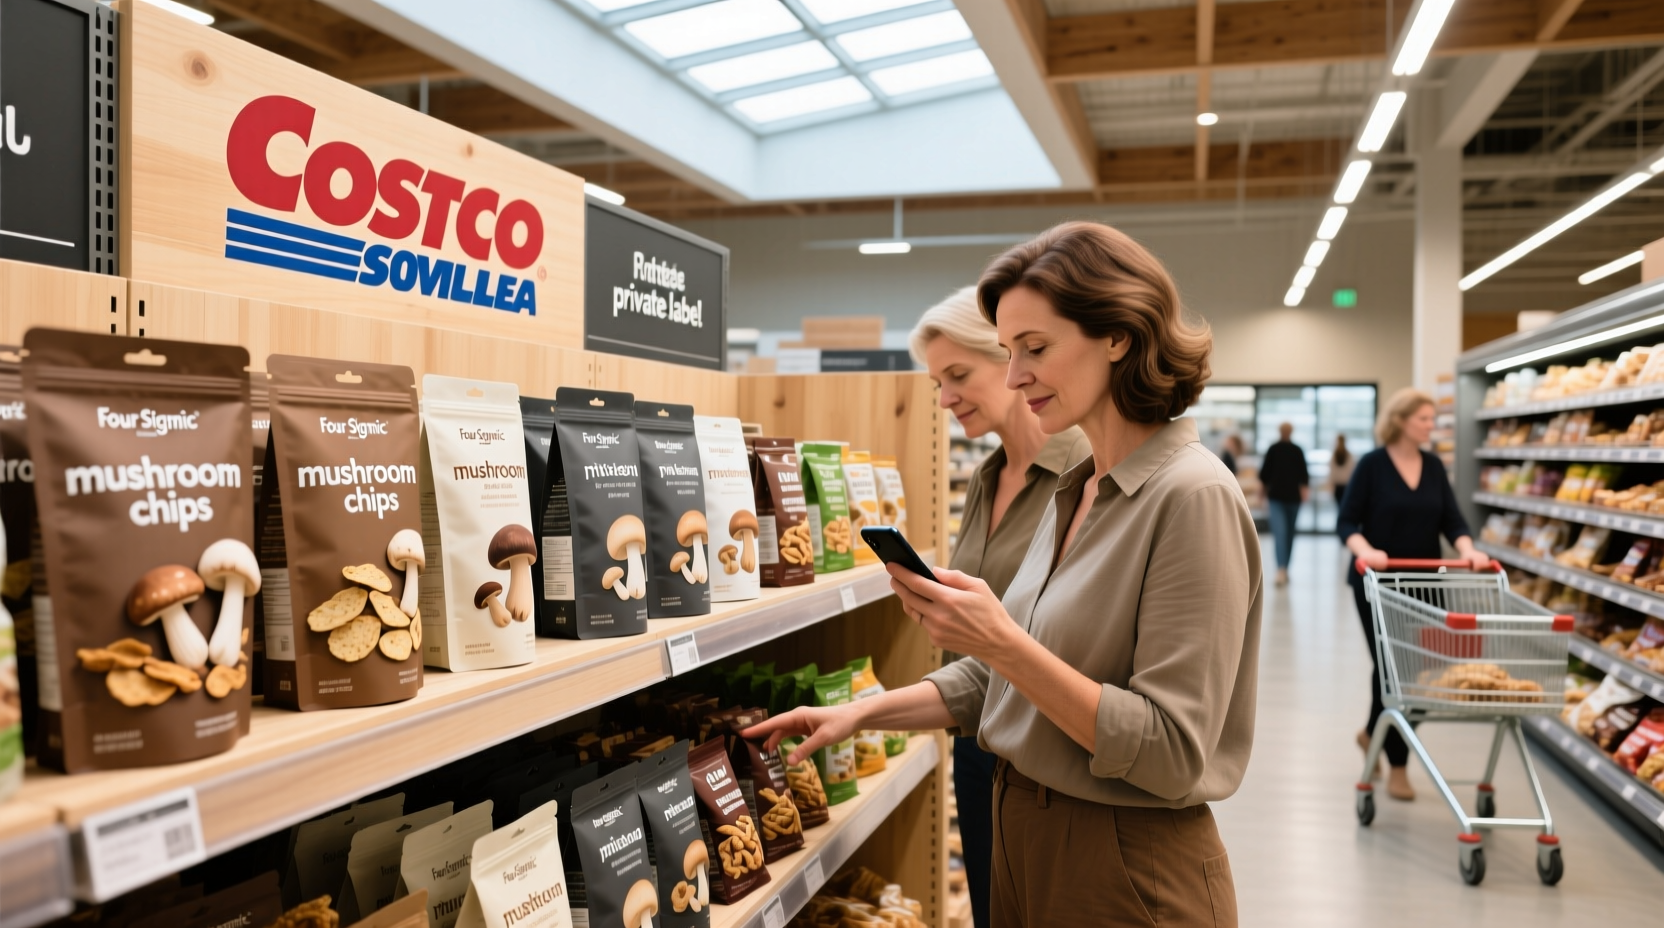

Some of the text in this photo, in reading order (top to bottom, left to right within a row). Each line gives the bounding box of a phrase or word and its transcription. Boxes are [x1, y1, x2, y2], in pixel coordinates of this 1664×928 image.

[226, 95, 544, 270] COSTCO
[613, 283, 667, 319] private
[97, 406, 199, 435] Four Sigmic
[320, 416, 346, 434] Four
[65, 455, 241, 496] mushroom
[298, 457, 416, 488] mushroom
[453, 460, 525, 480] mushroom
[129, 489, 214, 532] chips
[344, 486, 399, 519] chips
